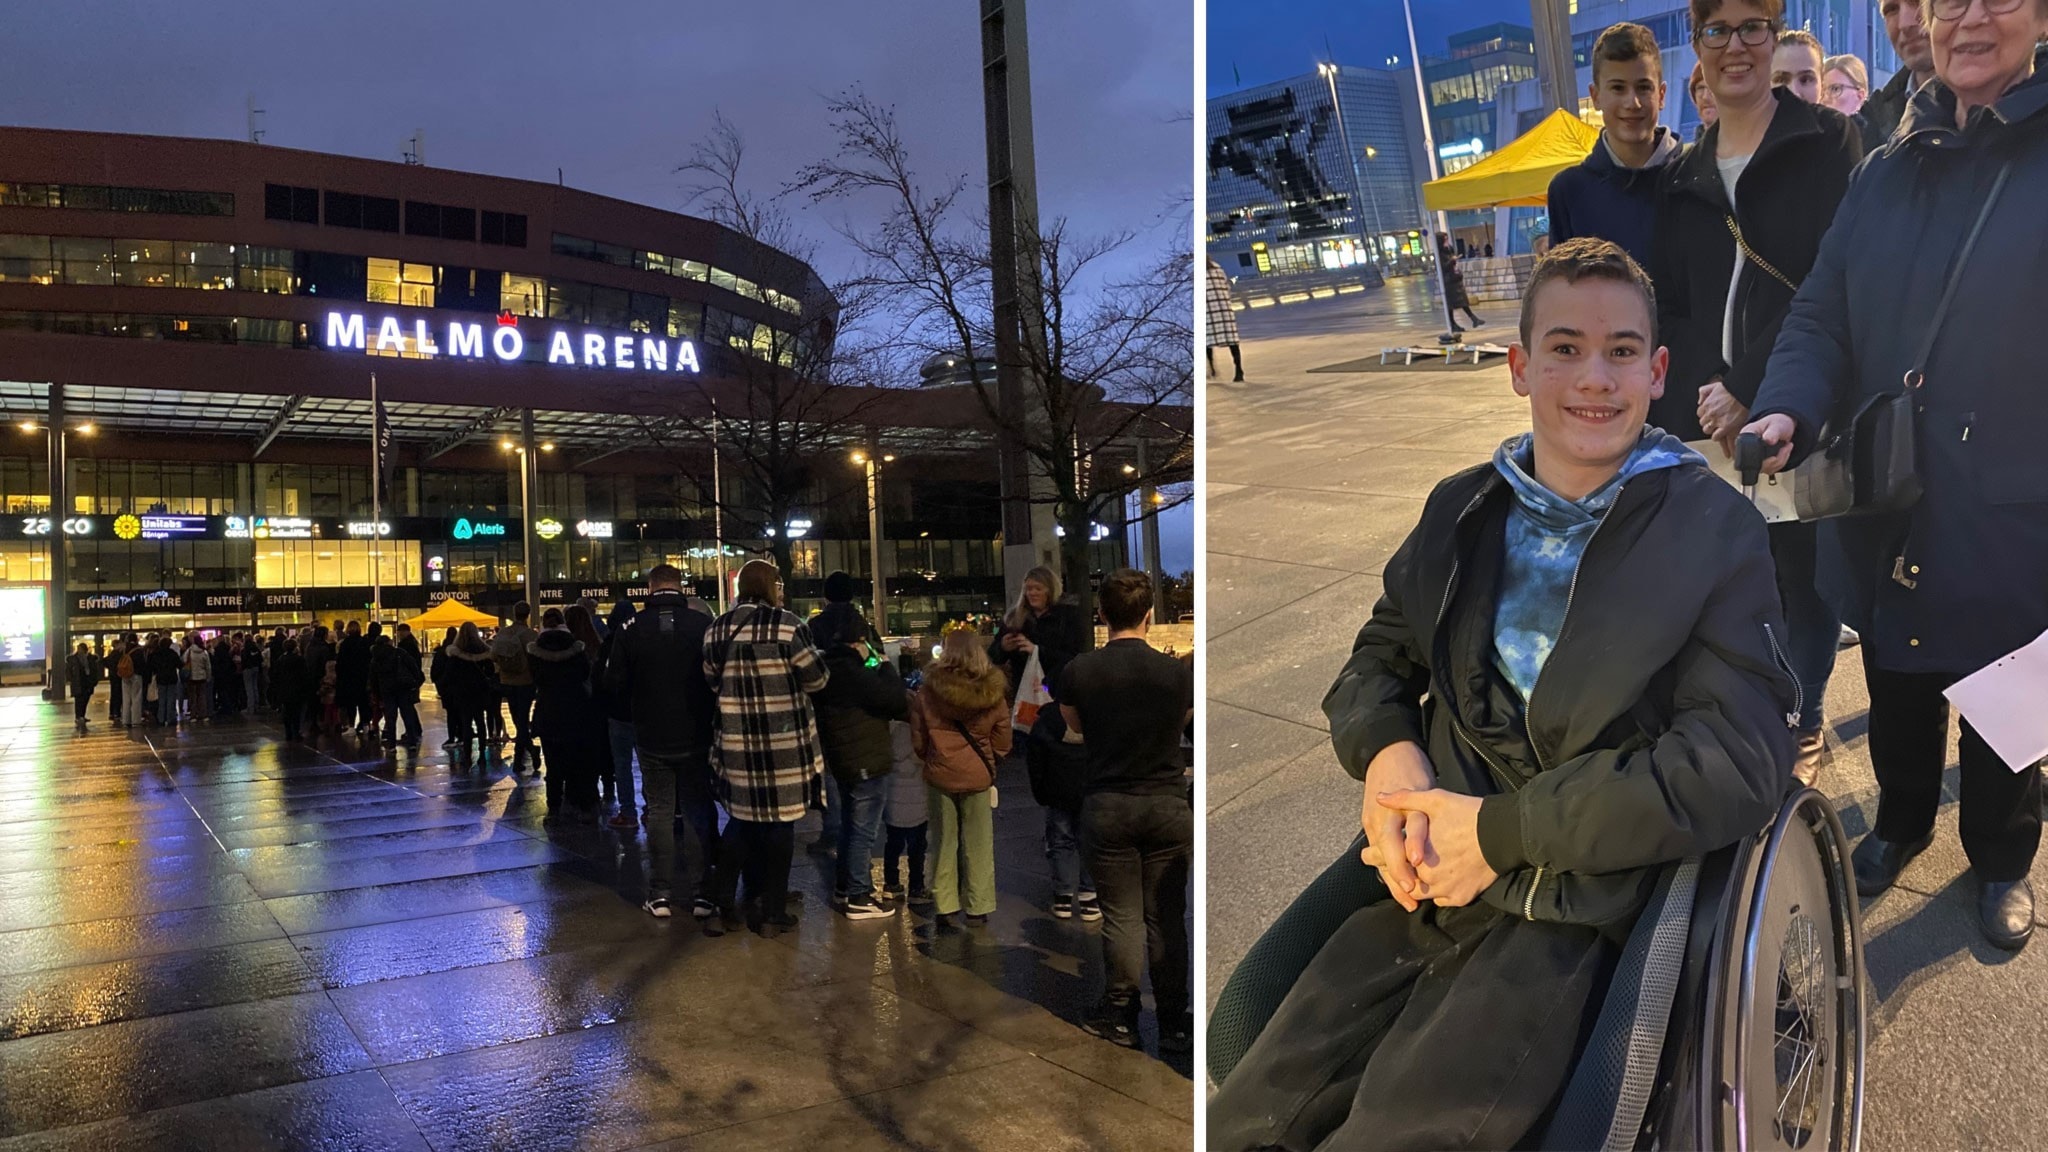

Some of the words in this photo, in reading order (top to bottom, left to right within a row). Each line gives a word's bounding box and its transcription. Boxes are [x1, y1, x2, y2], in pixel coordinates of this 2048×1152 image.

[549, 331, 700, 372] ARENA
[141, 519, 182, 529] Unilabs
[474, 523, 505, 535] Aleris
[430, 592, 470, 601] KONTOR
[540, 590, 563, 598] NTRE
[627, 588, 650, 597] ENTR
